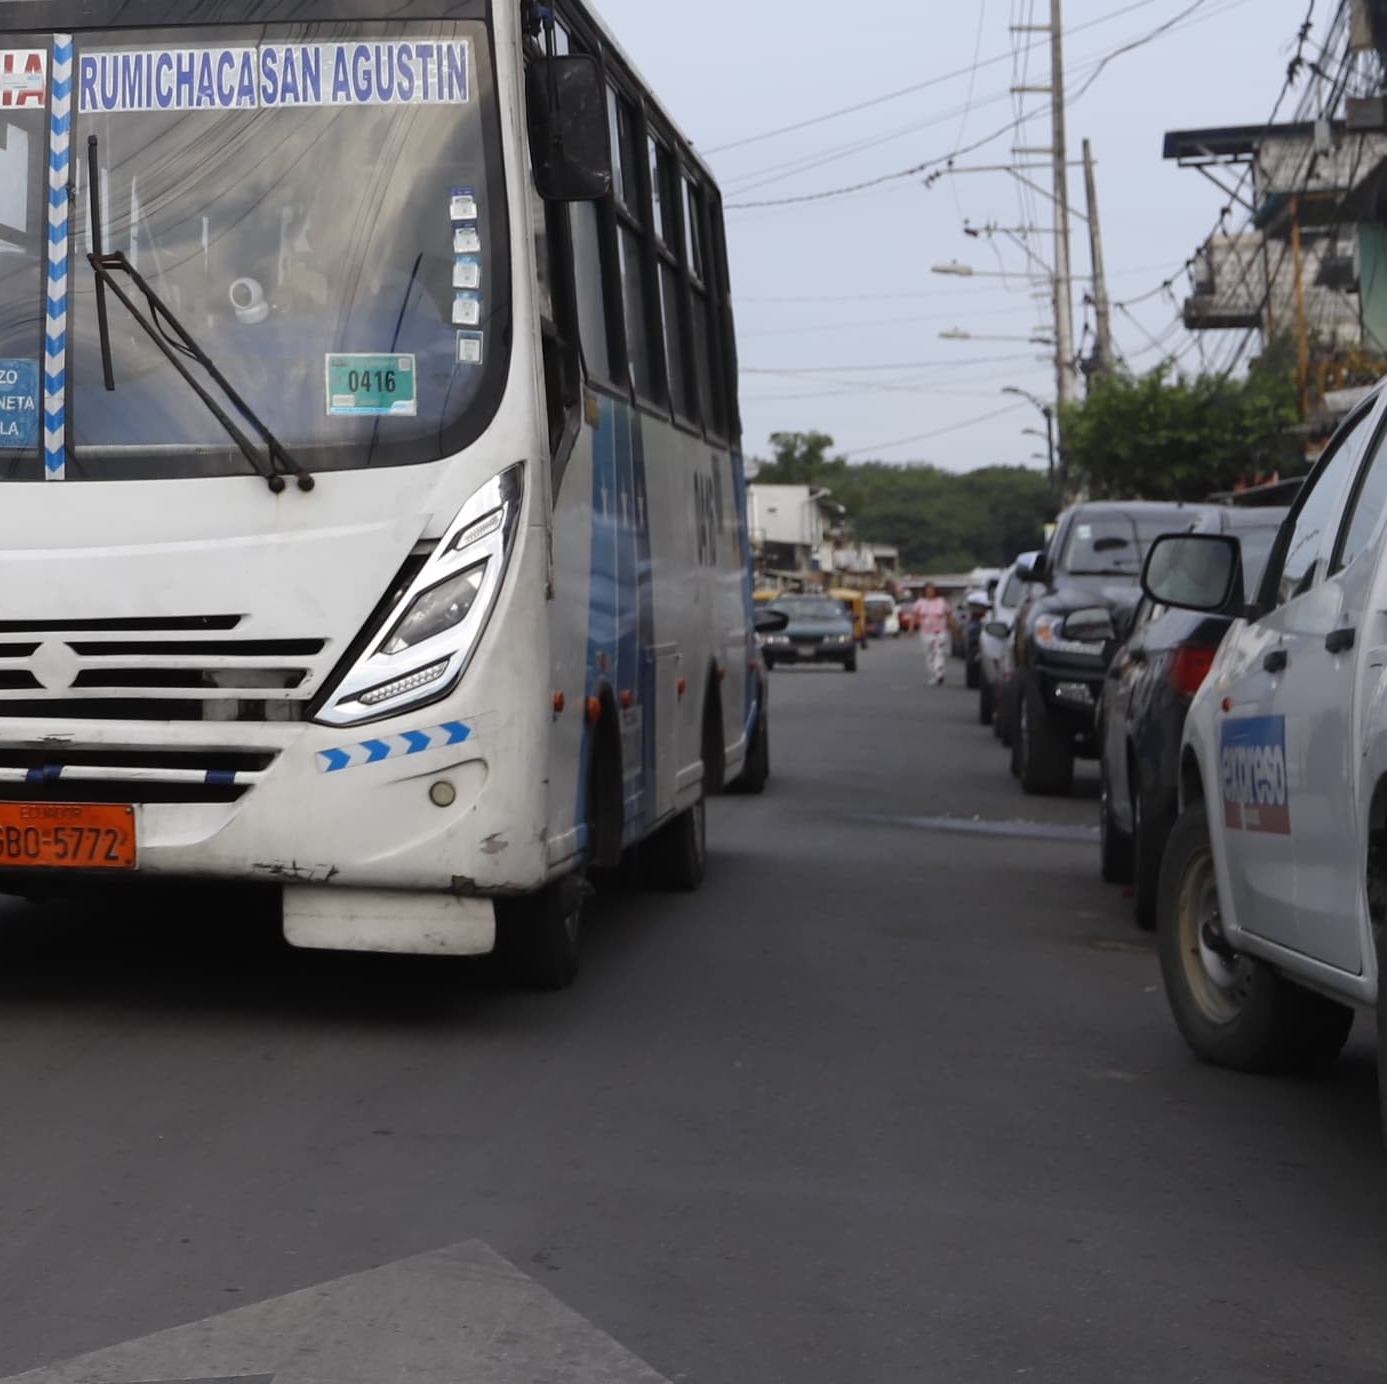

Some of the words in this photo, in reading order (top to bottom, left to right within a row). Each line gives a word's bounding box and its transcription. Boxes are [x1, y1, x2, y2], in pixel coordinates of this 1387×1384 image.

[80, 51, 255, 111] RUMICHACA
[260, 47, 321, 108] SAN
[332, 44, 468, 102] AGUSTIN
[348, 370, 396, 393] 0416
